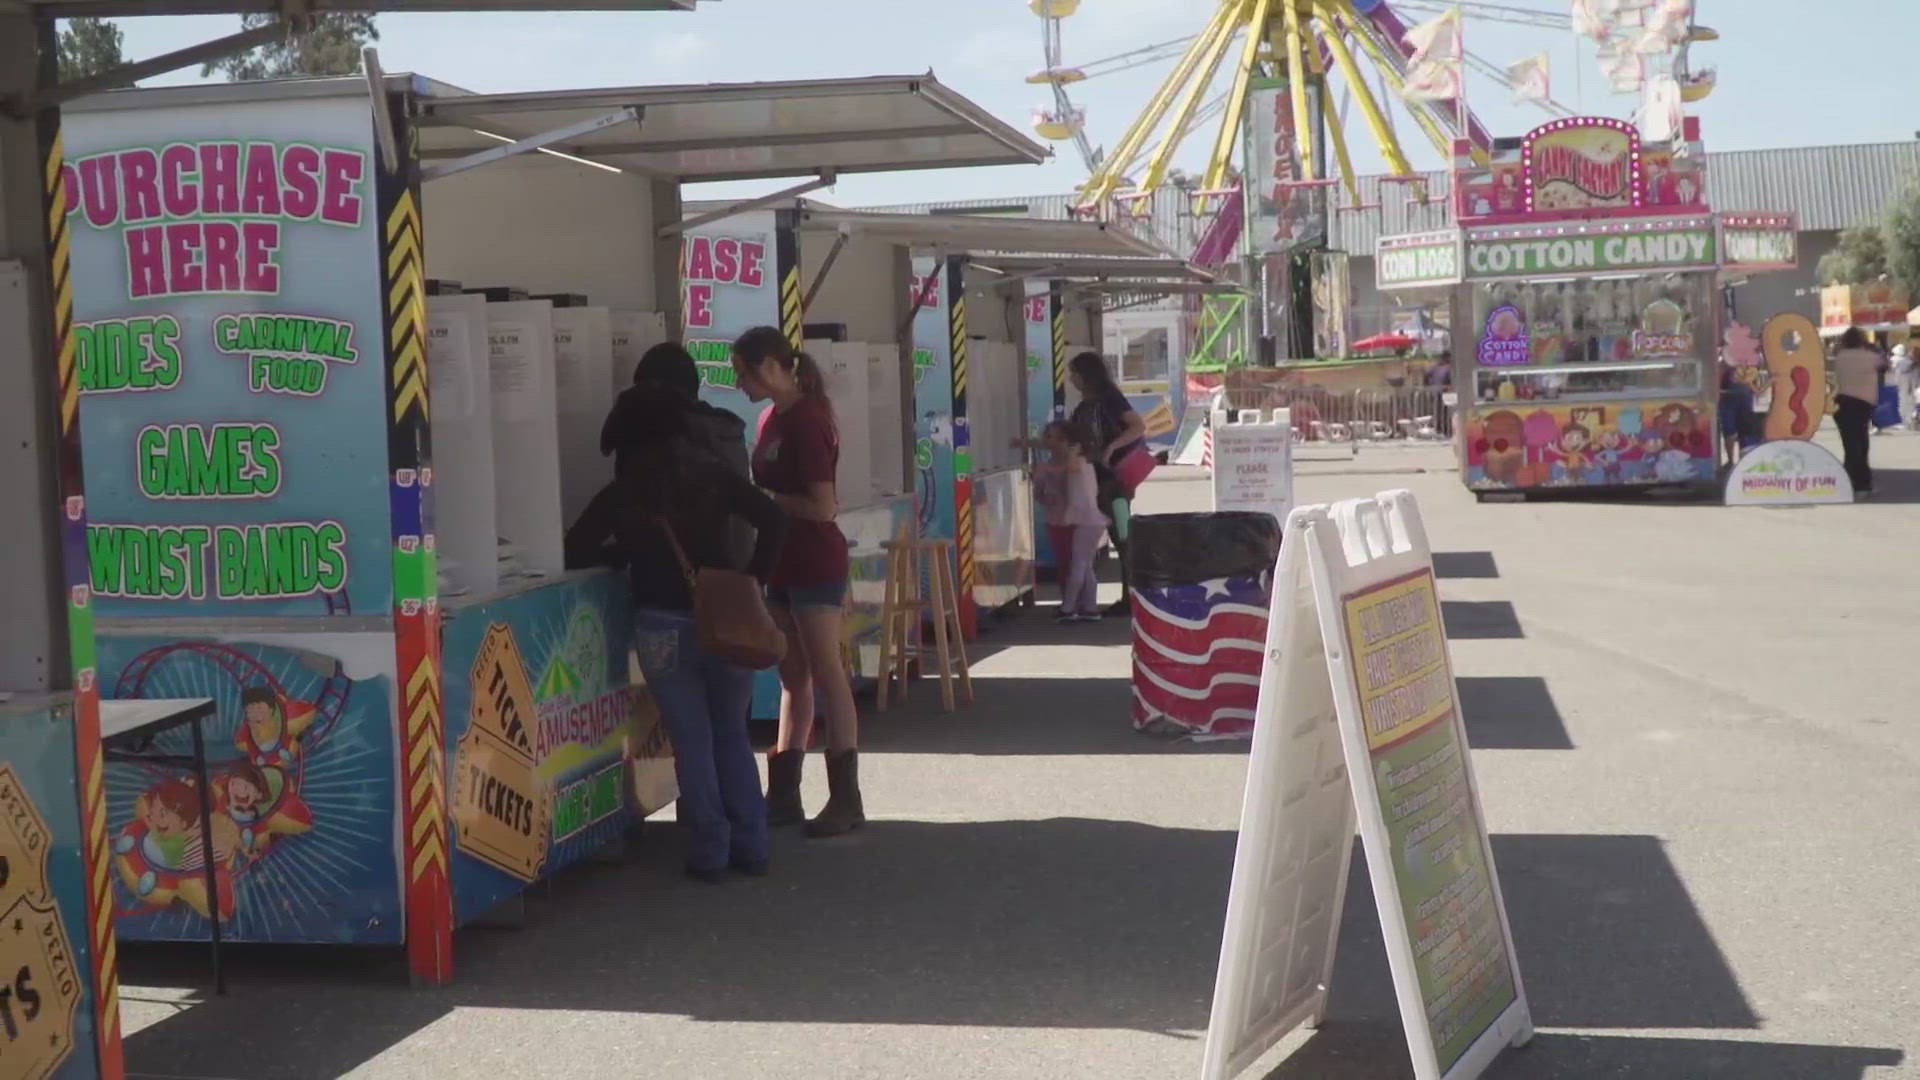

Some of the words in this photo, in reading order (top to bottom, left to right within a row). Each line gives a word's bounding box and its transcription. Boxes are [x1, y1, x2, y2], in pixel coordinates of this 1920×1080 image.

[126, 222, 280, 298] HERE
[1382, 251, 1416, 281] CORN
[1418, 246, 1456, 278] DOGS
[1470, 239, 1594, 272] COTTON
[1604, 234, 1708, 264] CANDY
[74, 316, 181, 394] RIDES
[214, 315, 357, 362] CARNIVAL
[1484, 339, 1527, 350] COTTON
[1484, 350, 1527, 360] CANDY
[250, 357, 325, 395] FOOD
[139, 425, 281, 498] GAMES
[1236, 463, 1269, 475] PLEASE
[1743, 476, 1792, 492] MIDWAY
[1795, 478, 1809, 492] OF
[1812, 477, 1836, 487] FUN
[87, 524, 208, 598] WRIST
[216, 521, 346, 598] BANDS
[1365, 646, 1396, 690] HAVE
[488, 661, 533, 754] TICK
[470, 765, 534, 837] TICKETS
[43, 921, 72, 997] 01234
